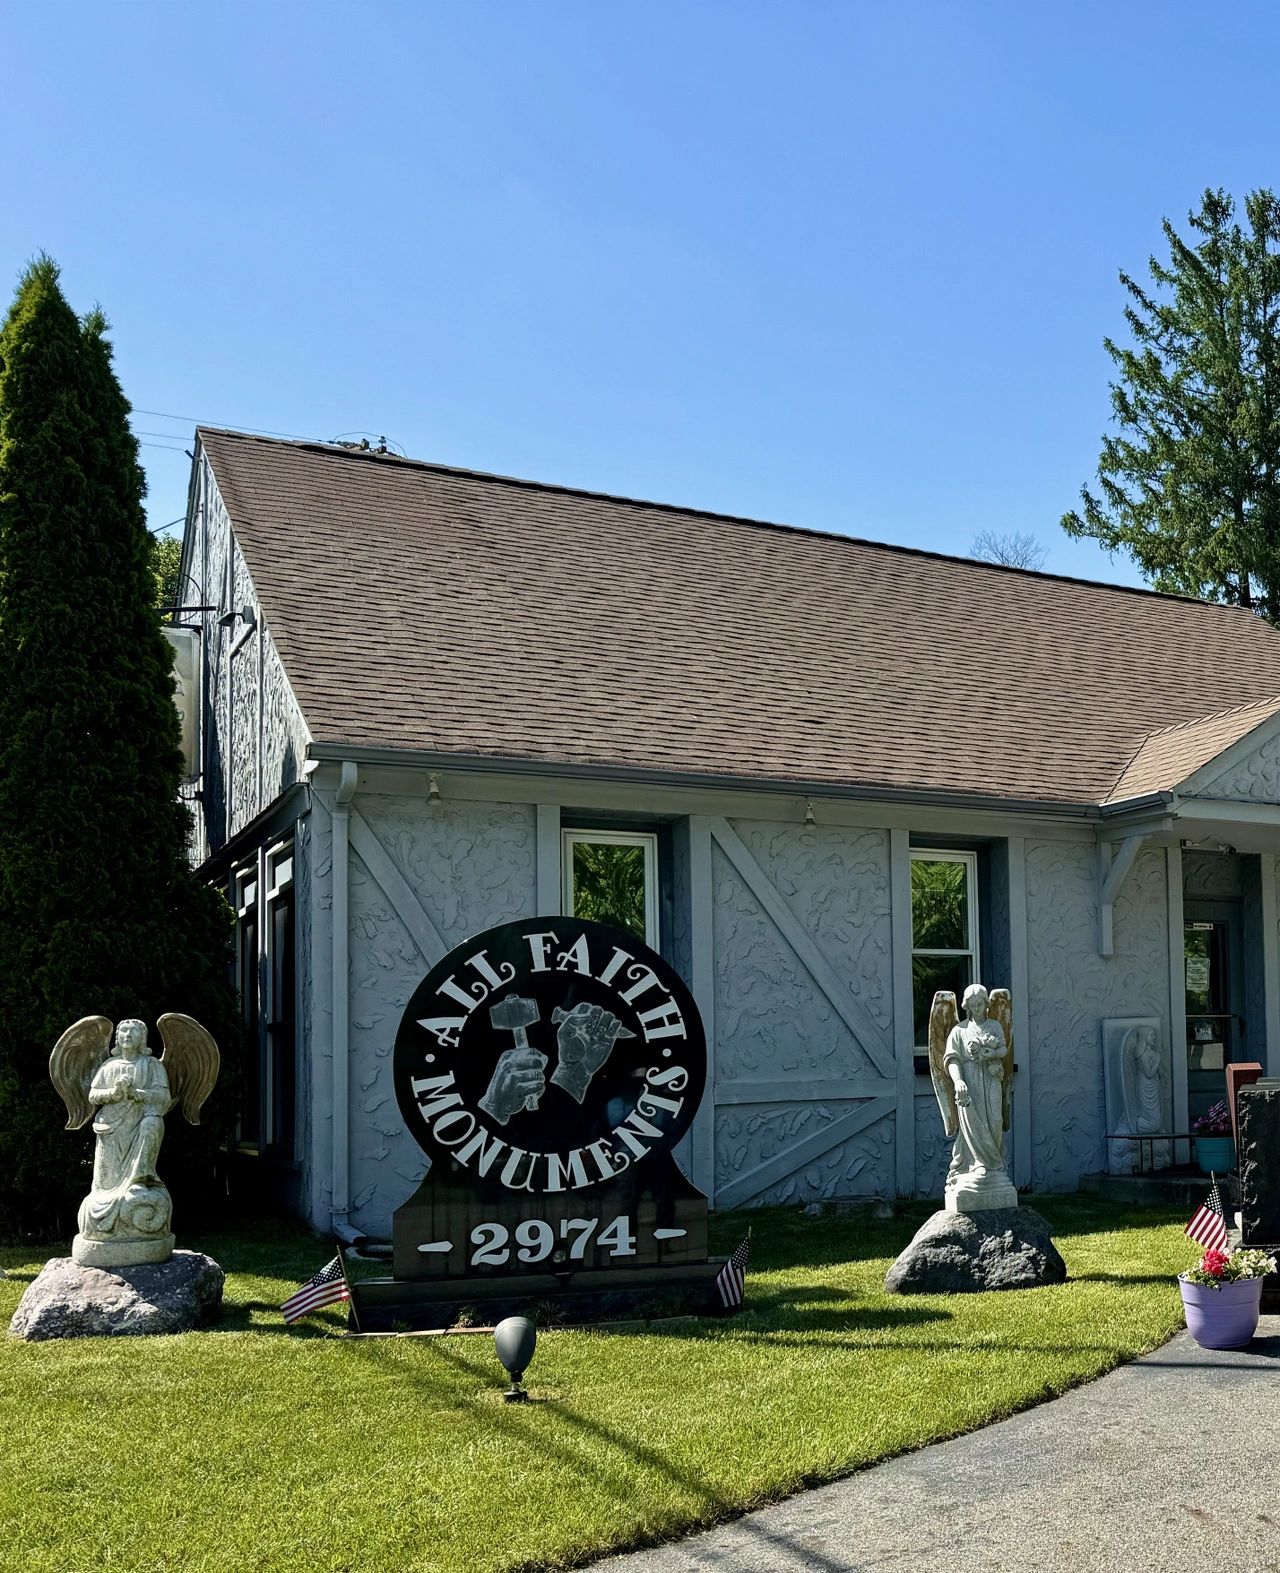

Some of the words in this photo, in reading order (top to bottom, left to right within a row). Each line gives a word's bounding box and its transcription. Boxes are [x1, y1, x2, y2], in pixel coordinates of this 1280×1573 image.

[416, 949, 516, 1048] ALL
[522, 931, 688, 1044] FAITH
[410, 1065, 689, 1193] MONUMENTS
[470, 1215, 637, 1267] 2974
